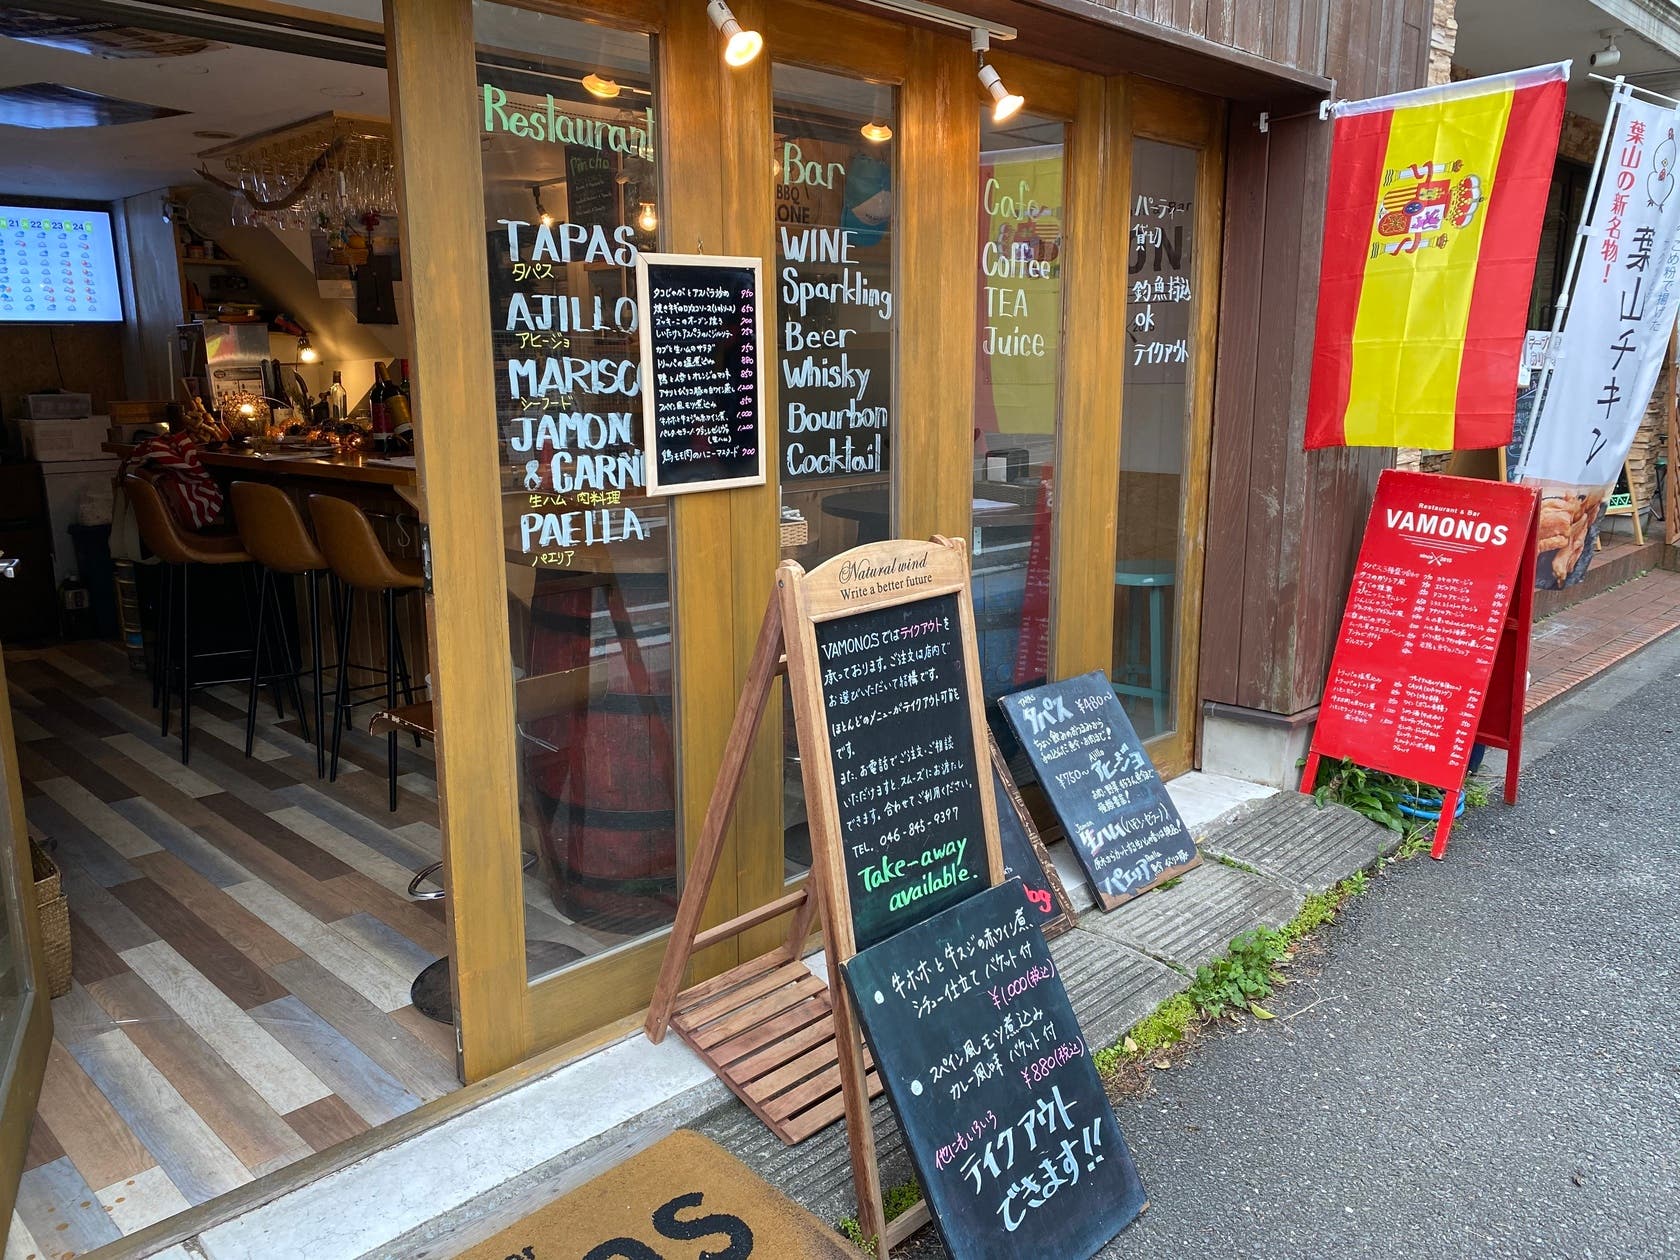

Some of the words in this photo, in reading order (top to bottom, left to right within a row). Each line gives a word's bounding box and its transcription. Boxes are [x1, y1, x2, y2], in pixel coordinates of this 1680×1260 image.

[483, 83, 654, 162] Restaurant
[784, 142, 846, 190] Bar
[776, 184, 800, 205] BBQ
[1134, 194, 1185, 220] パーティー
[8, 219, 20, 228] 21
[30, 220, 42, 229] 22
[52, 221, 64, 230] 23
[72, 223, 85, 231] 24
[497, 218, 638, 268] TAPAS
[1132, 223, 1163, 252] 貸切
[780, 226, 861, 264] WINE
[982, 241, 1051, 279] Coffee
[512, 263, 555, 282] タパス
[506, 291, 639, 334] AJILLO
[740, 288, 754, 299] 950
[740, 306, 754, 314] 650
[782, 266, 893, 321] Sparkling
[984, 286, 1028, 318] TEA
[515, 332, 571, 350] アヒージョ
[785, 321, 857, 351] Beer
[983, 326, 1046, 357] Juice
[1133, 339, 1190, 366] テイクアウト
[1585, 225, 1656, 466] 葉山チキン
[508, 356, 641, 400] MARISC
[782, 353, 872, 401] Whisky
[521, 396, 574, 411] シーフード
[787, 398, 888, 434] Bourbon
[511, 411, 633, 452] JAMON
[786, 433, 881, 476] Cocktail
[523, 459, 543, 491] &
[1386, 508, 1510, 546] VAMONOS
[1418, 502, 1458, 514] Restaurant
[1467, 509, 1481, 517] Bar
[520, 507, 645, 554] PAELLA
[531, 550, 575, 567] パエリア
[838, 557, 898, 585] Natural
[898, 552, 929, 574] wind
[840, 582, 869, 601] Write
[869, 587, 876, 595] a
[876, 575, 905, 593] better
[905, 573, 934, 588] future
[1022, 695, 1075, 736] タパス
[835, 740, 856, 760] です。
[1090, 742, 1146, 783] アヒージョ
[879, 806, 959, 847] 046-845-9397
[857, 836, 968, 893] Take-away
[1103, 857, 1151, 896] パエリア
[888, 863, 979, 912] available.
[949, 1053, 1004, 1100] カレー風味
[935, 1110, 998, 1171] 他にもいろいろ
[960, 1085, 1078, 1195] テイクアウト
[996, 1117, 1104, 1232] できます!!
